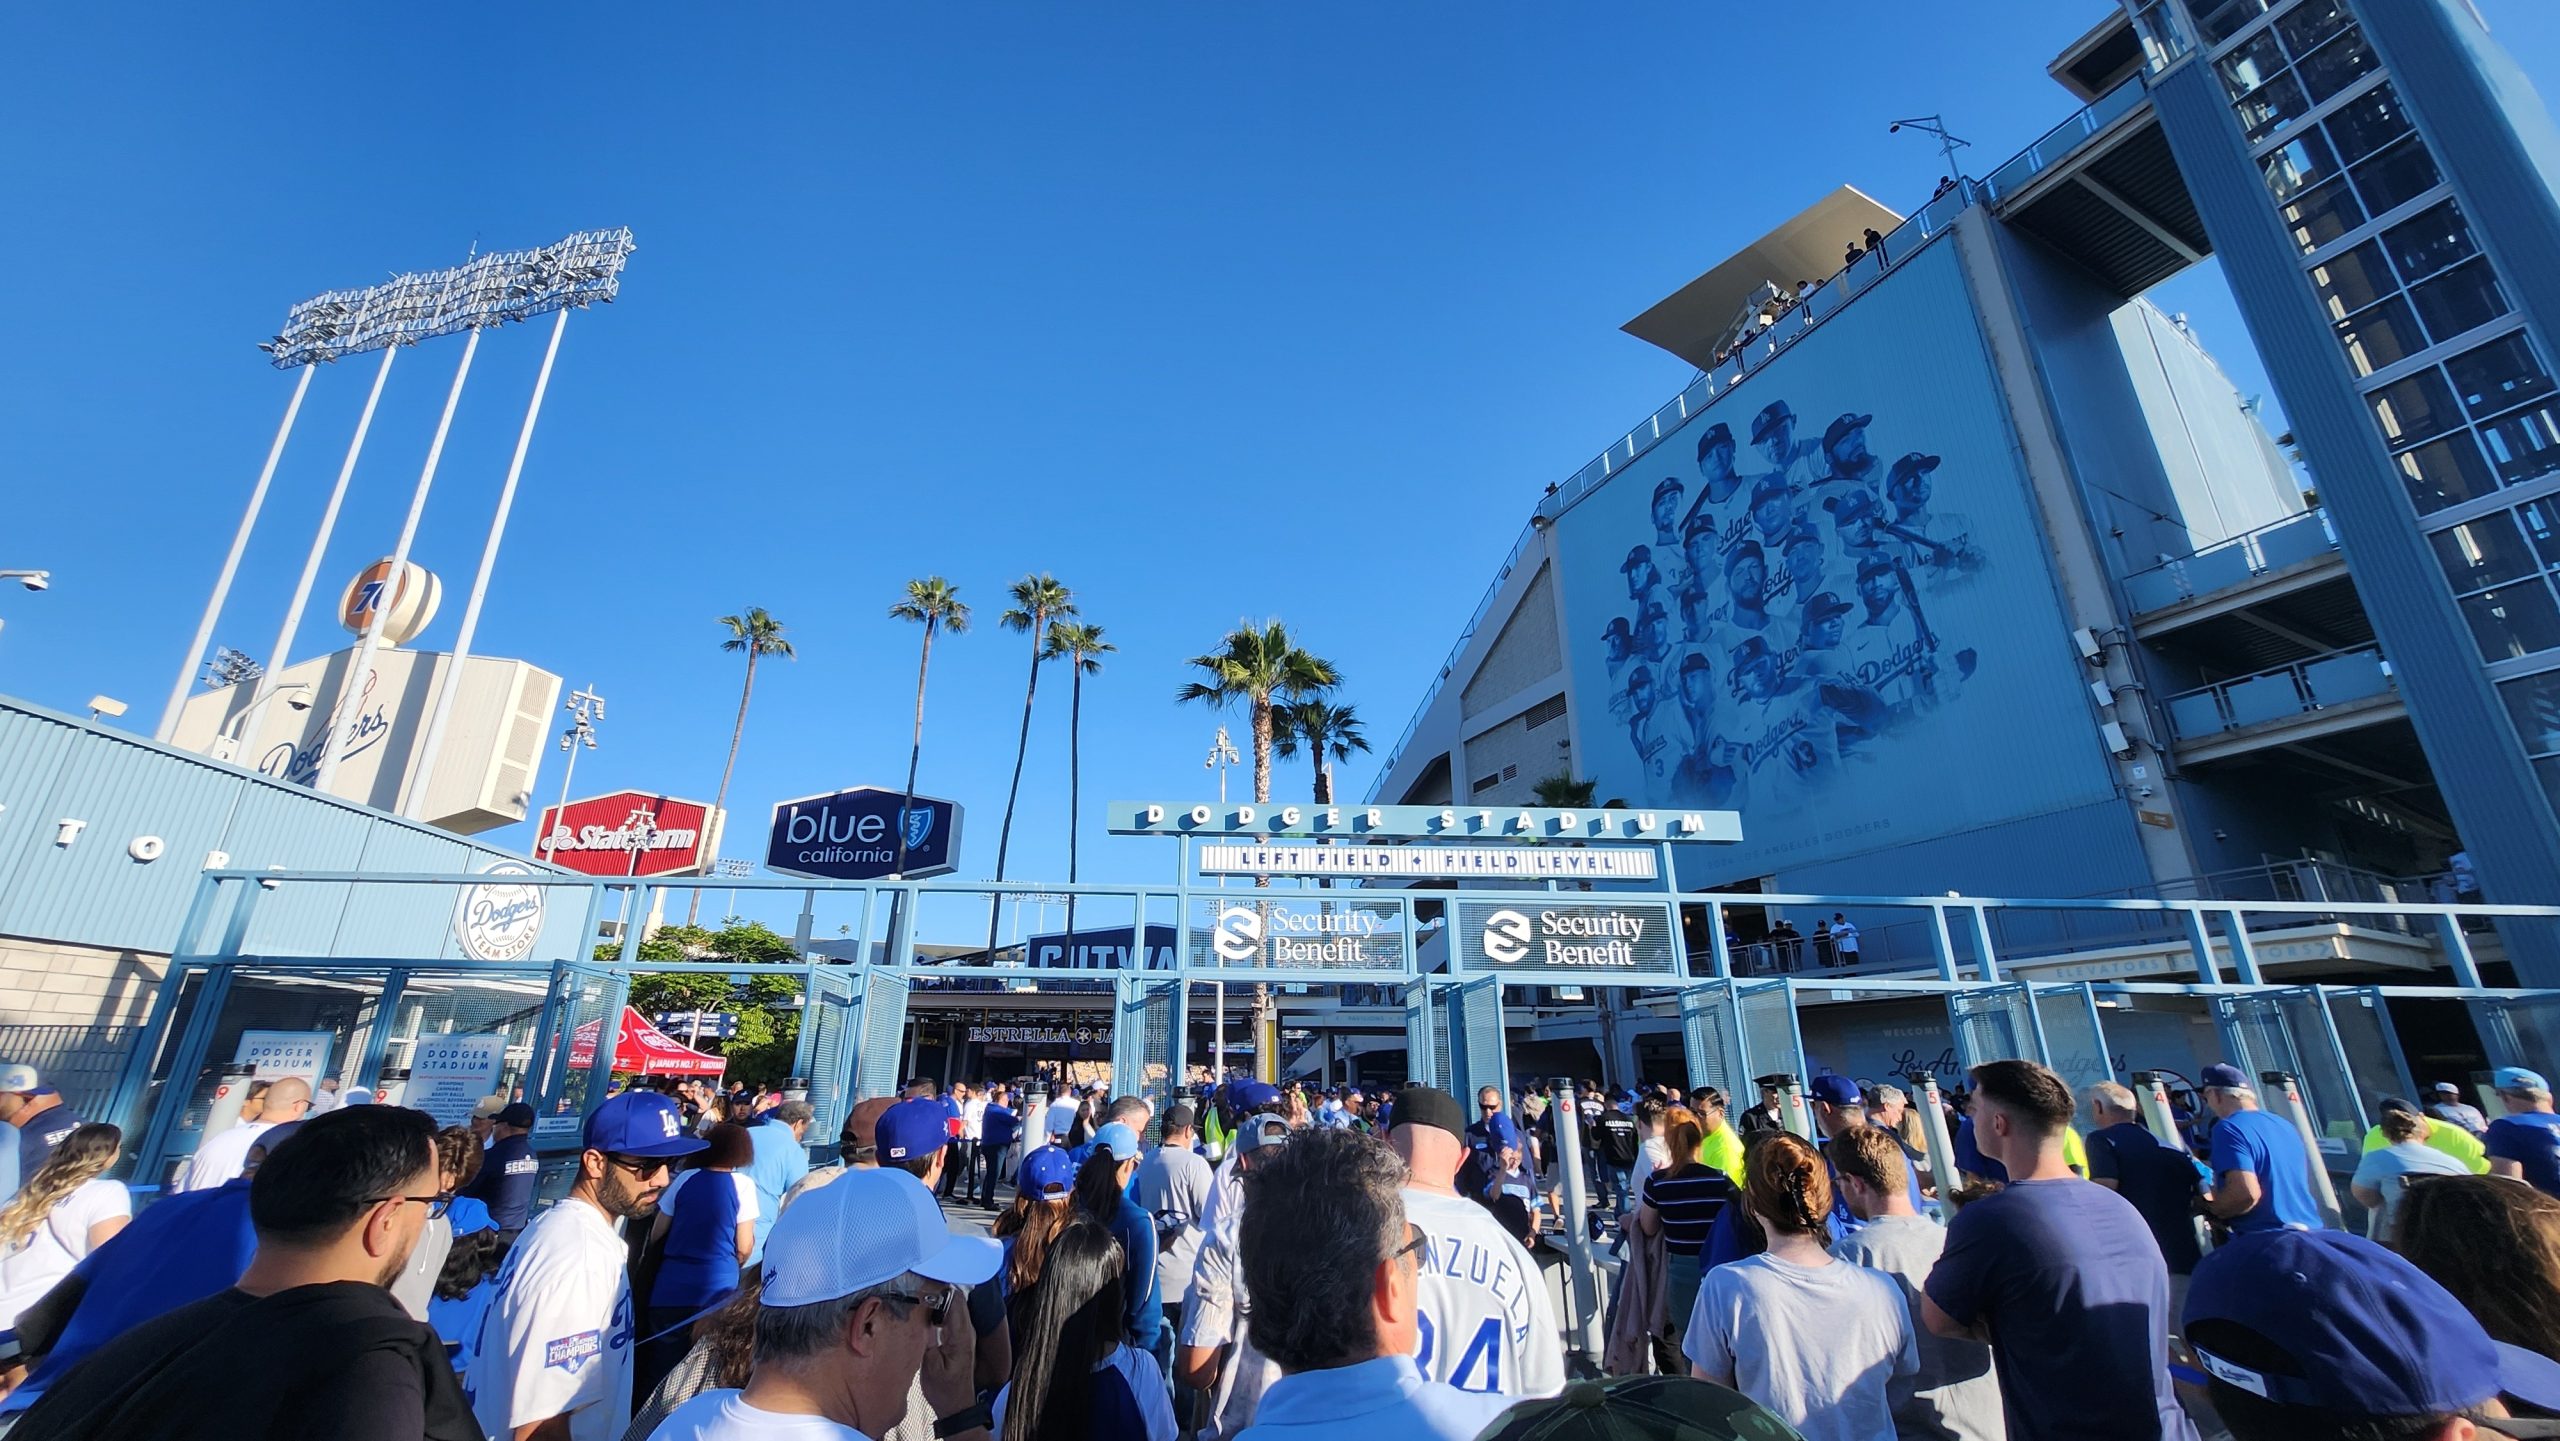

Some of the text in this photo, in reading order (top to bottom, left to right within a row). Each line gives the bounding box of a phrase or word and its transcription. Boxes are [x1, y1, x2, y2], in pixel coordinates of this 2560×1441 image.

[1857, 631, 1941, 692] Dodges
[259, 703, 389, 785] Doders
[786, 806, 886, 844] blue
[1147, 804, 1706, 832] DODGER STADIUM
[1824, 817, 1891, 843] DODGERS
[0, 804, 287, 890] TOR
[798, 846, 893, 863] california
[1242, 851, 1391, 867] LEFT FIELD
[1445, 855, 1613, 870] FIELD LEVEL
[470, 895, 539, 933] Dodgers
[1273, 907, 1377, 938] Security
[1541, 911, 1645, 943] Security
[474, 925, 536, 958] TEAM STORE
[1274, 934, 1363, 962] Benefit
[1544, 940, 1636, 966] Benefit
[2056, 943, 2314, 978] ELEVATORS ESLTORS
[967, 1026, 1072, 1044] ESTRELLA
[1882, 1026, 1942, 1038] WELCOME
[250, 1047, 313, 1057] DODGER
[427, 1049, 489, 1059] DODGER
[421, 1061, 489, 1070] STADIUM
[217, 1086, 229, 1099] 9
[376, 1090, 388, 1104] 9
[1928, 1092, 1936, 1104] 5
[2155, 1092, 2165, 1103] 4
[2287, 1092, 2298, 1103] 4
[1028, 1103, 1037, 1117] 7
[1561, 1100, 1571, 1112] 6
[1792, 1095, 1801, 1108] 5
[659, 1109, 681, 1138] LA
[504, 1160, 540, 1175] SECURI
[549, 1342, 598, 1361] CHAMPIONS
